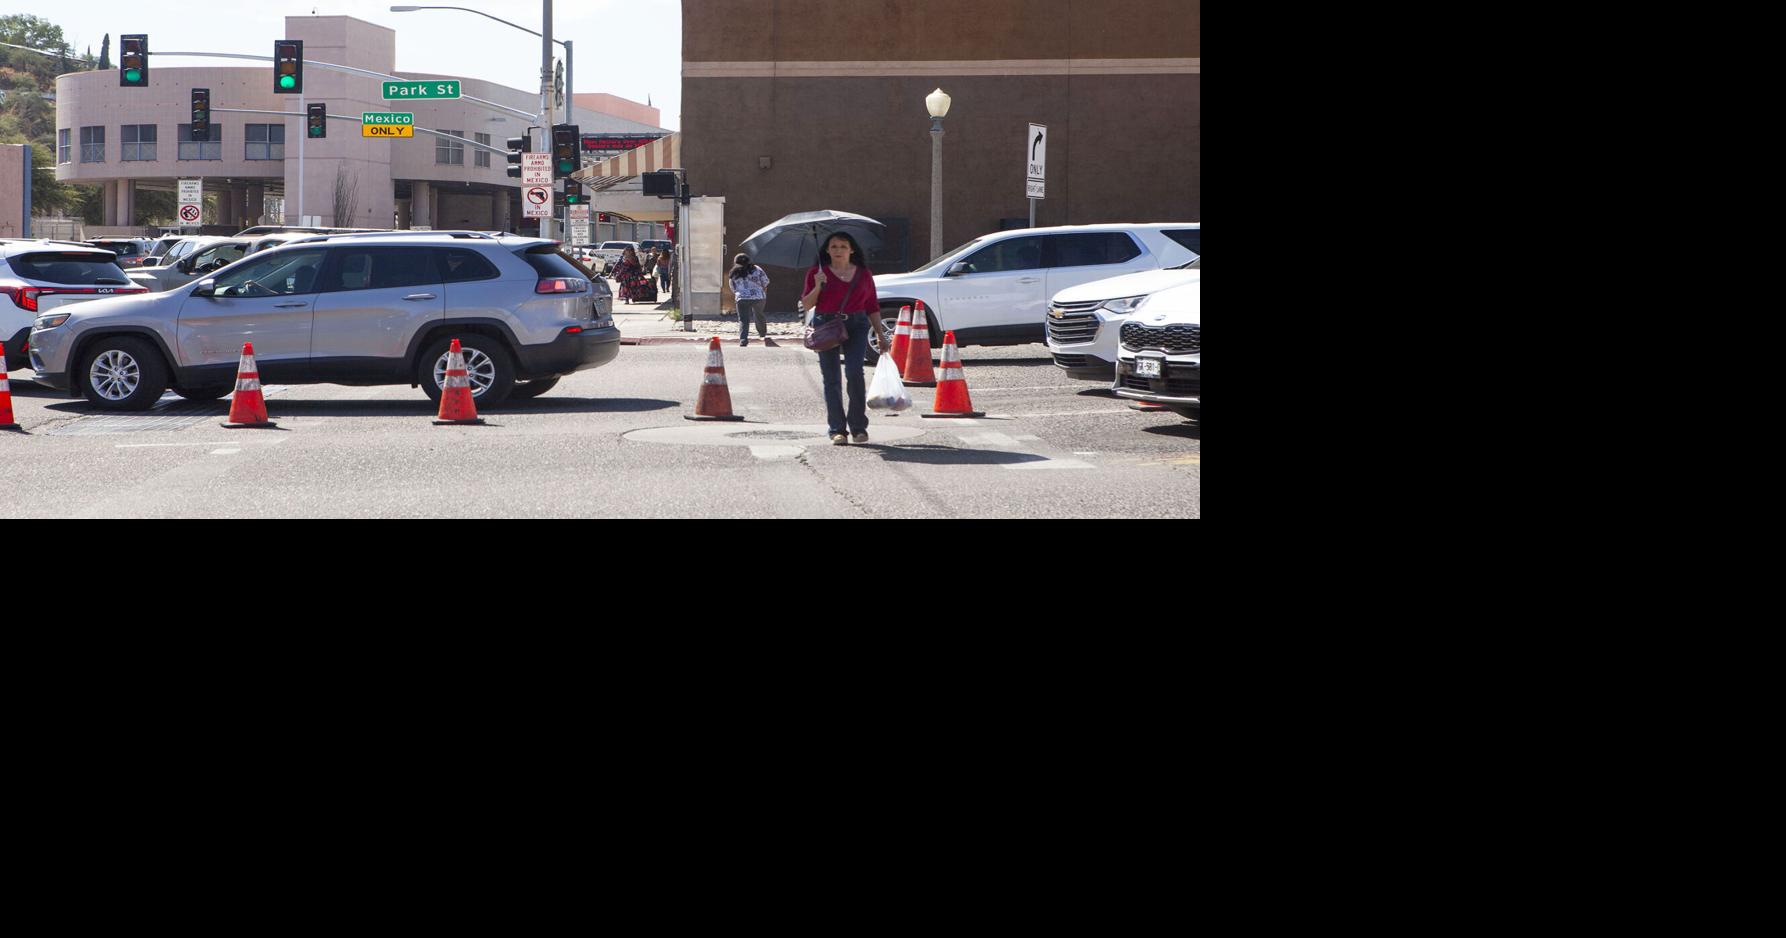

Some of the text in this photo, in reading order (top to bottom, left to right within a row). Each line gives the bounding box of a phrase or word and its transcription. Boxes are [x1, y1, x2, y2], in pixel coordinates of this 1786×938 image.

[389, 84, 454, 96] Park St
[365, 114, 411, 123] Mexico
[370, 127, 405, 135] ONLY
[1029, 163, 1043, 175] ONLY
